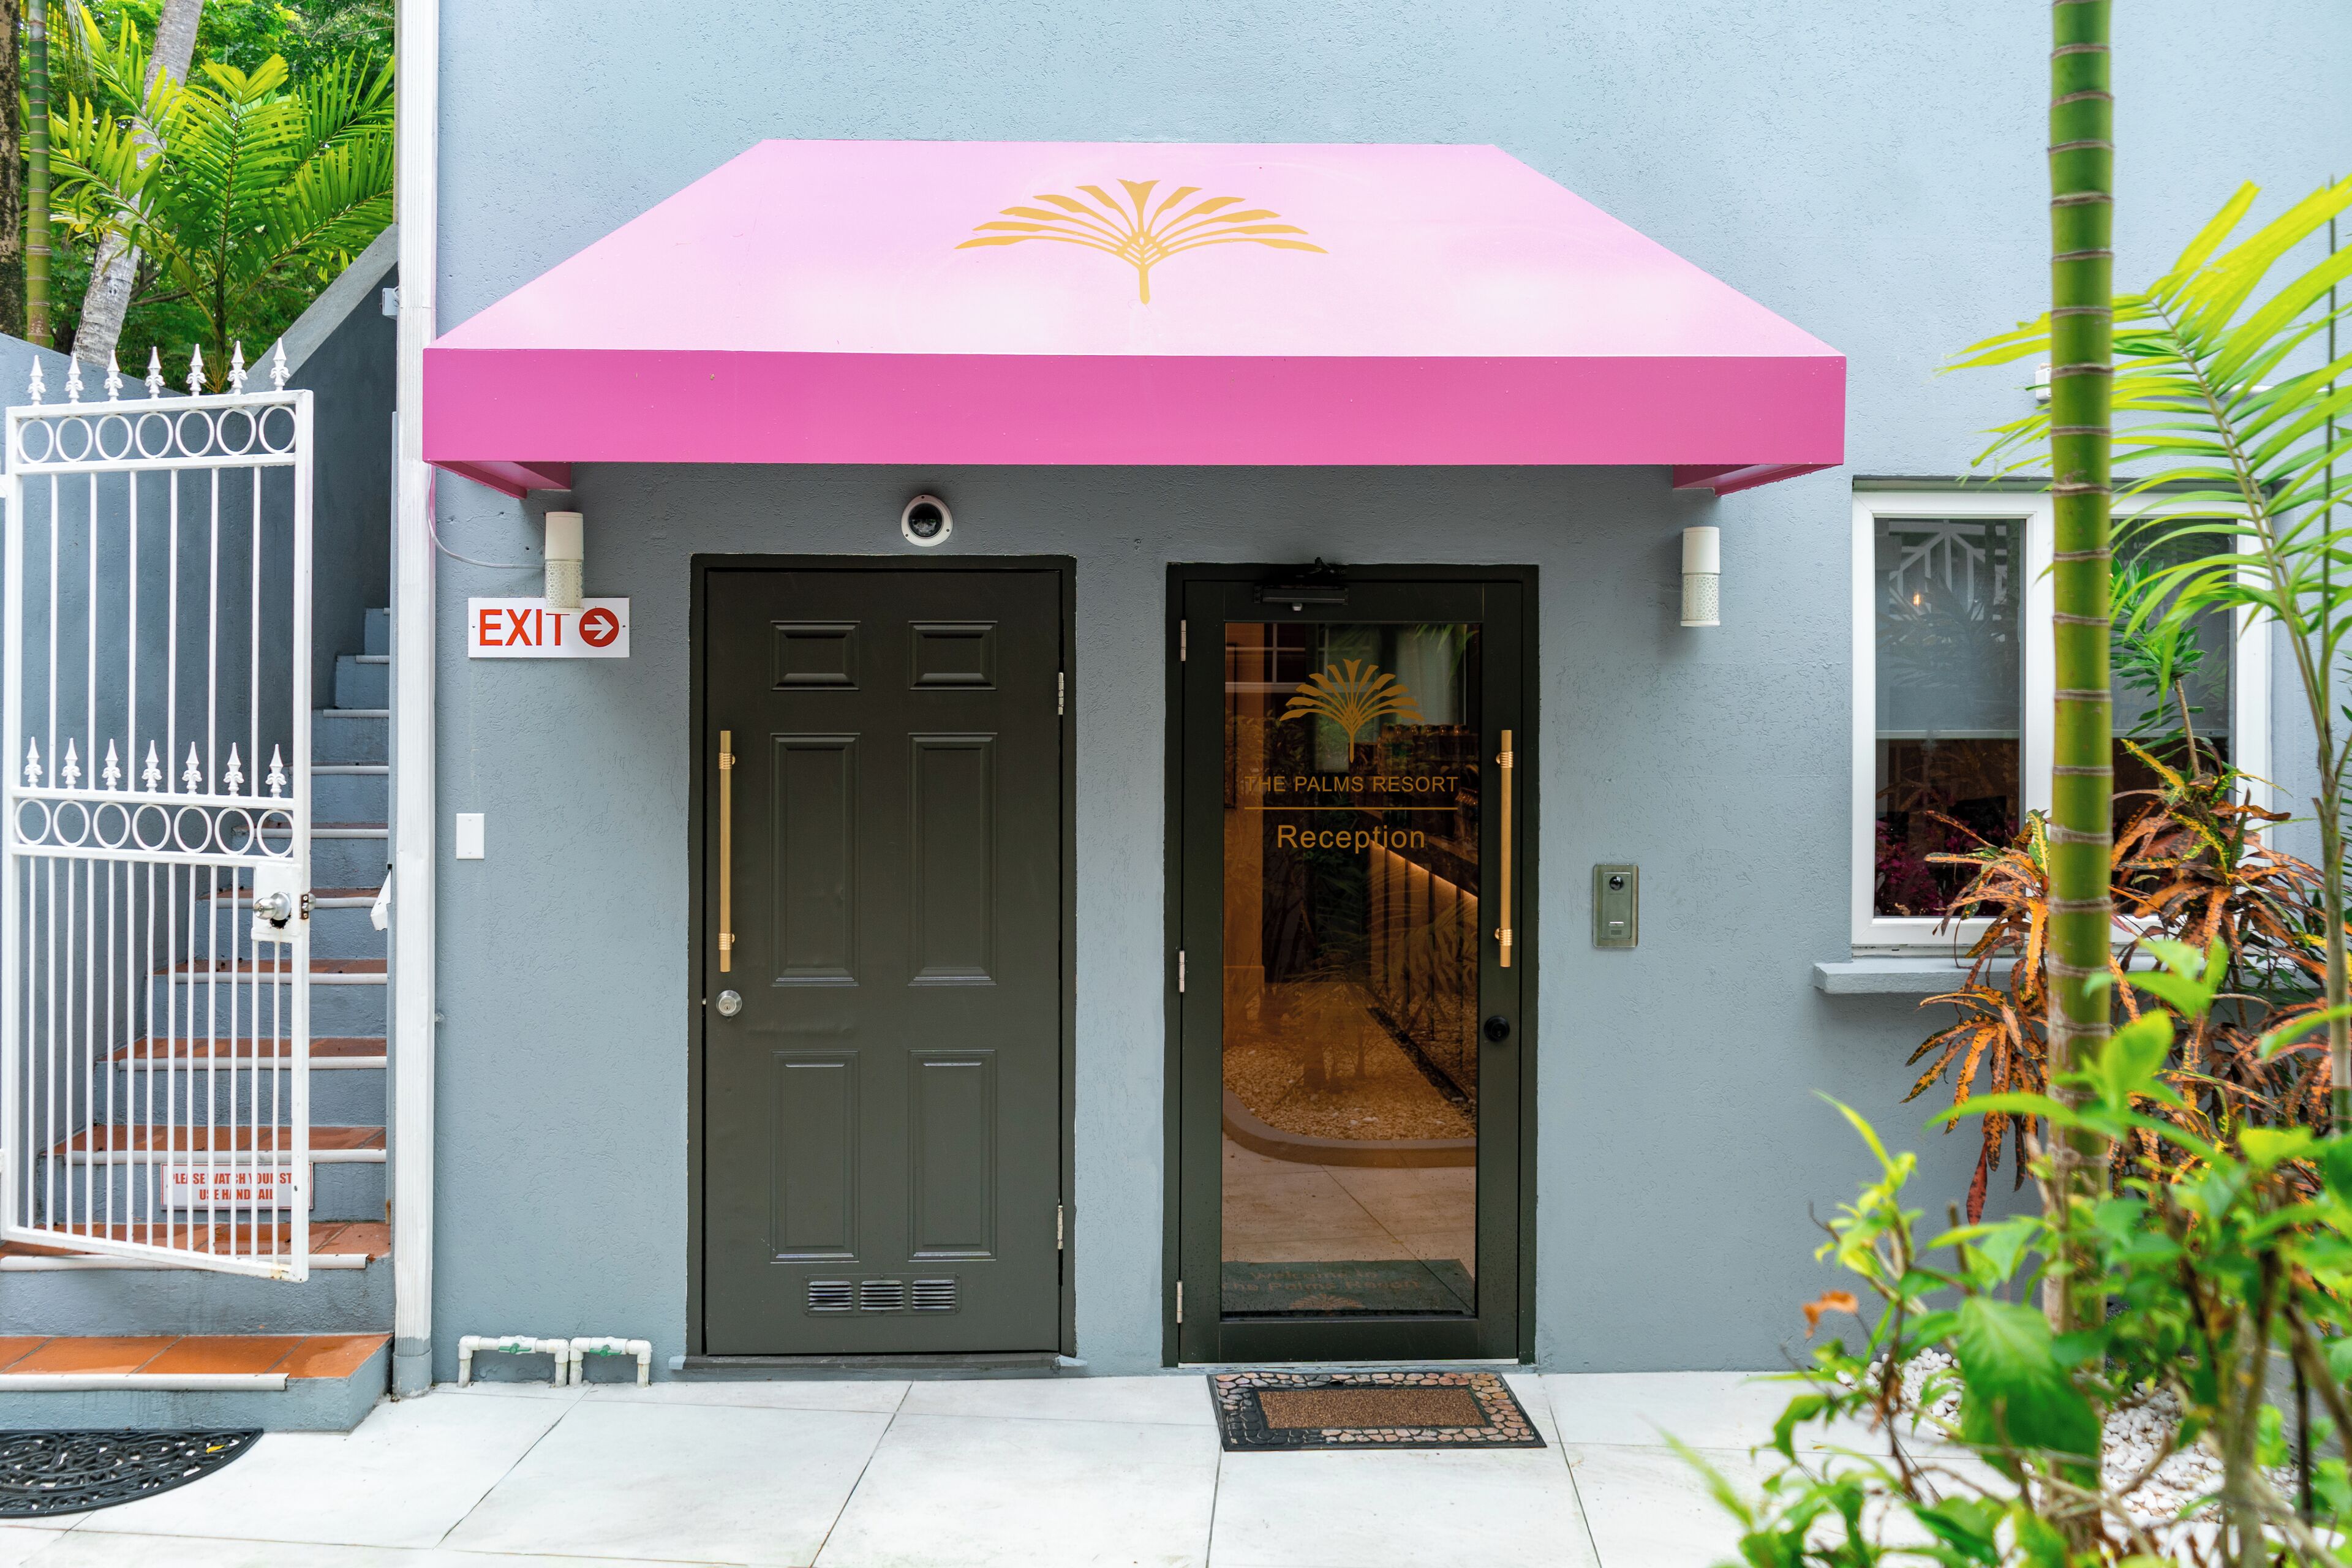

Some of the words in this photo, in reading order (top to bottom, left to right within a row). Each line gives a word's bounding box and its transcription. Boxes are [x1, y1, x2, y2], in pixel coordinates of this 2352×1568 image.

[479, 608, 570, 646] EXIT
[1244, 775, 1286, 792] THE
[1295, 775, 1364, 792] PALMS
[1372, 775, 1458, 792] RESORT
[1277, 824, 1425, 854] Reception
[199, 1189, 219, 1200] UE
[222, 1189, 273, 1200] HNDAIL
